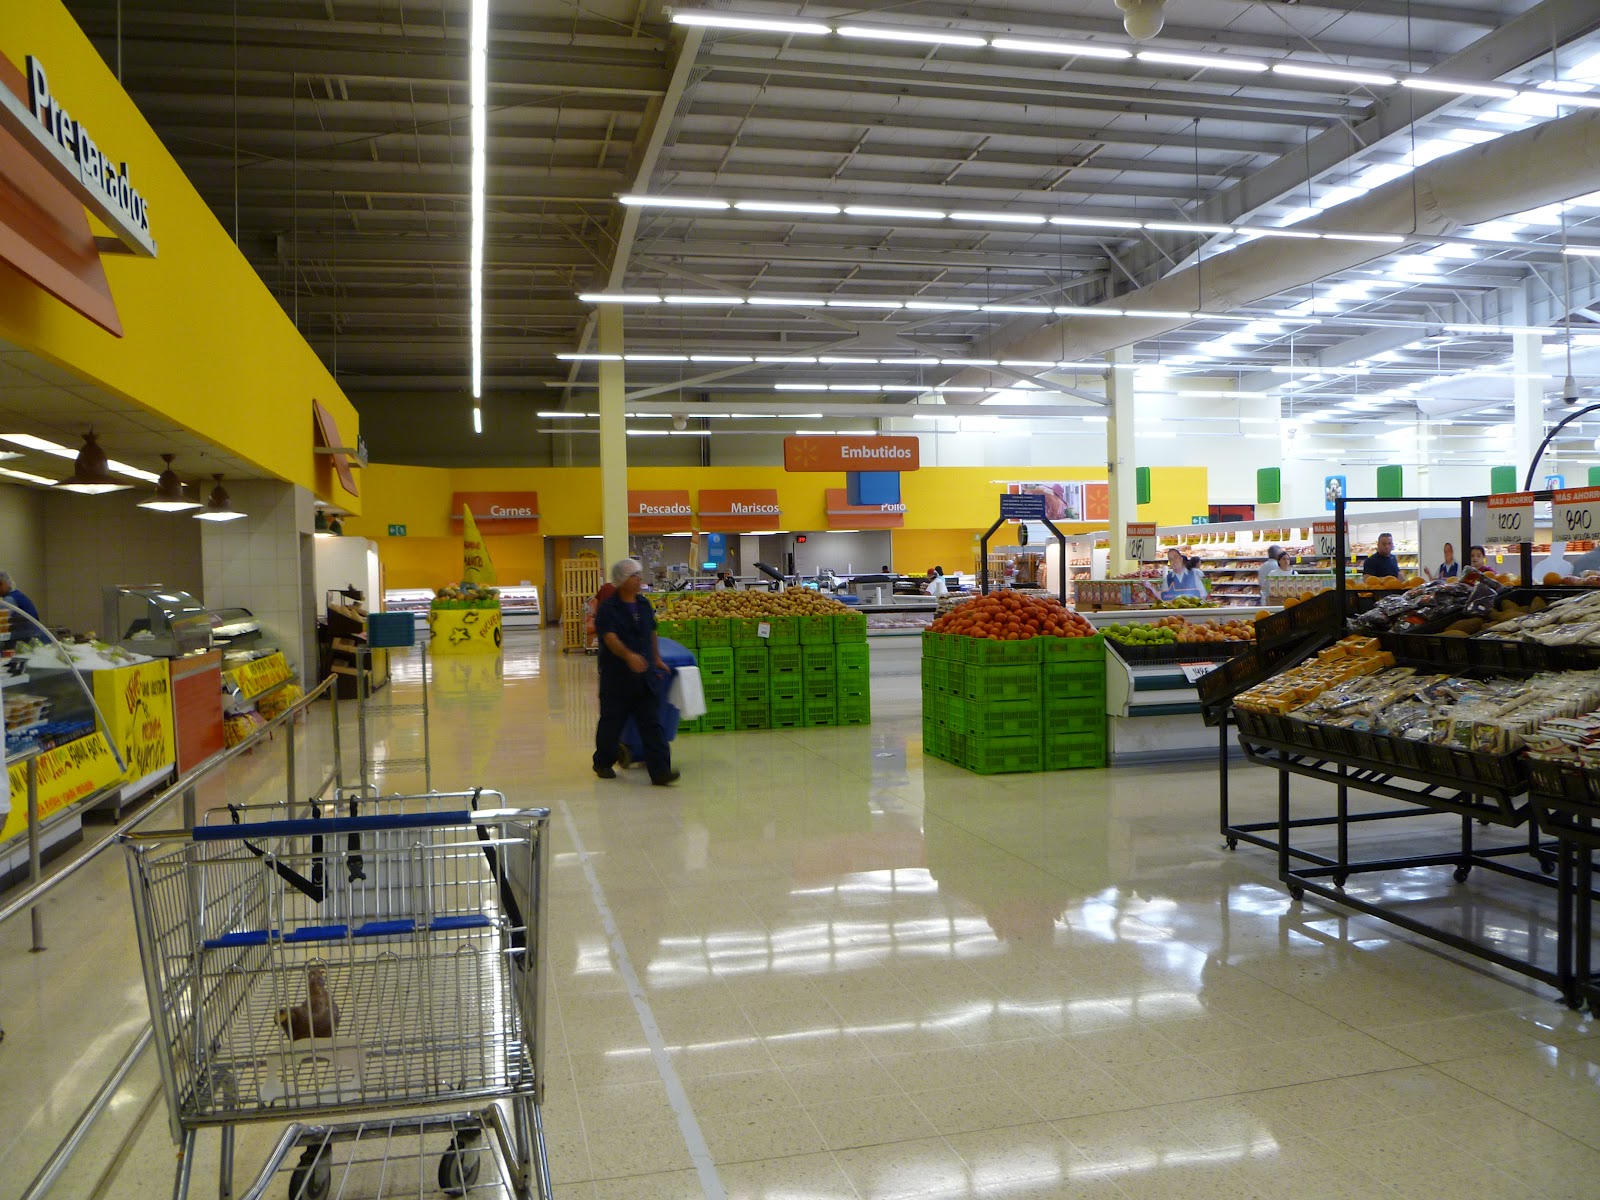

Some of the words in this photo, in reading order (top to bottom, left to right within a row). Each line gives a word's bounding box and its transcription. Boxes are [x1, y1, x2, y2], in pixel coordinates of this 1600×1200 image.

[26, 55, 150, 233] Preparados
[841, 445, 911, 459] Embutidos
[1505, 496, 1533, 505] AHORRO
[1573, 491, 1600, 500] AHORR
[490, 505, 531, 516] Carnes
[639, 503, 692, 514] Pescados
[731, 502, 780, 513] Mariscos
[881, 503, 906, 512] Pollo
[1499, 513, 1521, 529] 1200
[1566, 510, 1592, 530] 890
